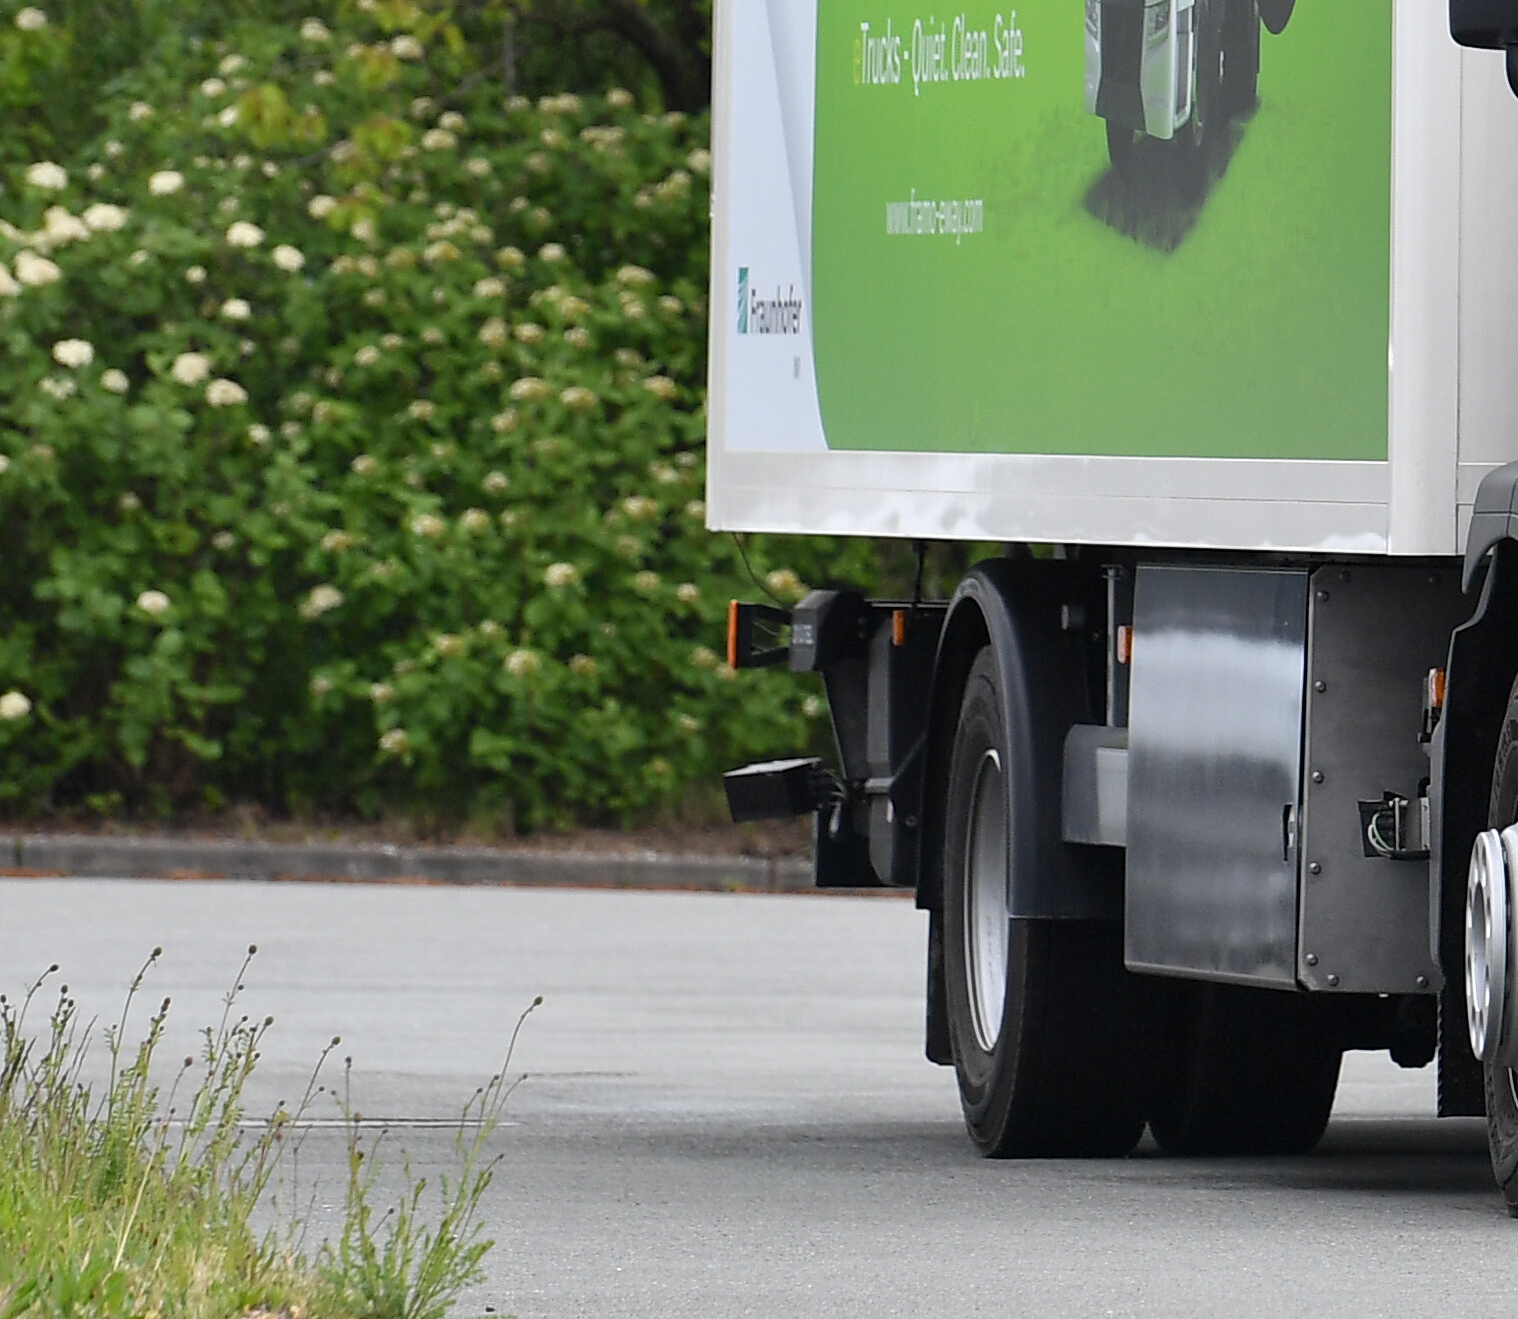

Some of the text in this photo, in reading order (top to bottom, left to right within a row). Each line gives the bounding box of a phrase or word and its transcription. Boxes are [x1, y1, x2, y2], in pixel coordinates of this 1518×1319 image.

[852, 17, 902, 85] eTrucks
[911, 15, 949, 97] Quiet.
[951, 13, 991, 81] Clean.
[993, 9, 1026, 79] Safe.
[750, 284, 802, 334] Fraunhofer
